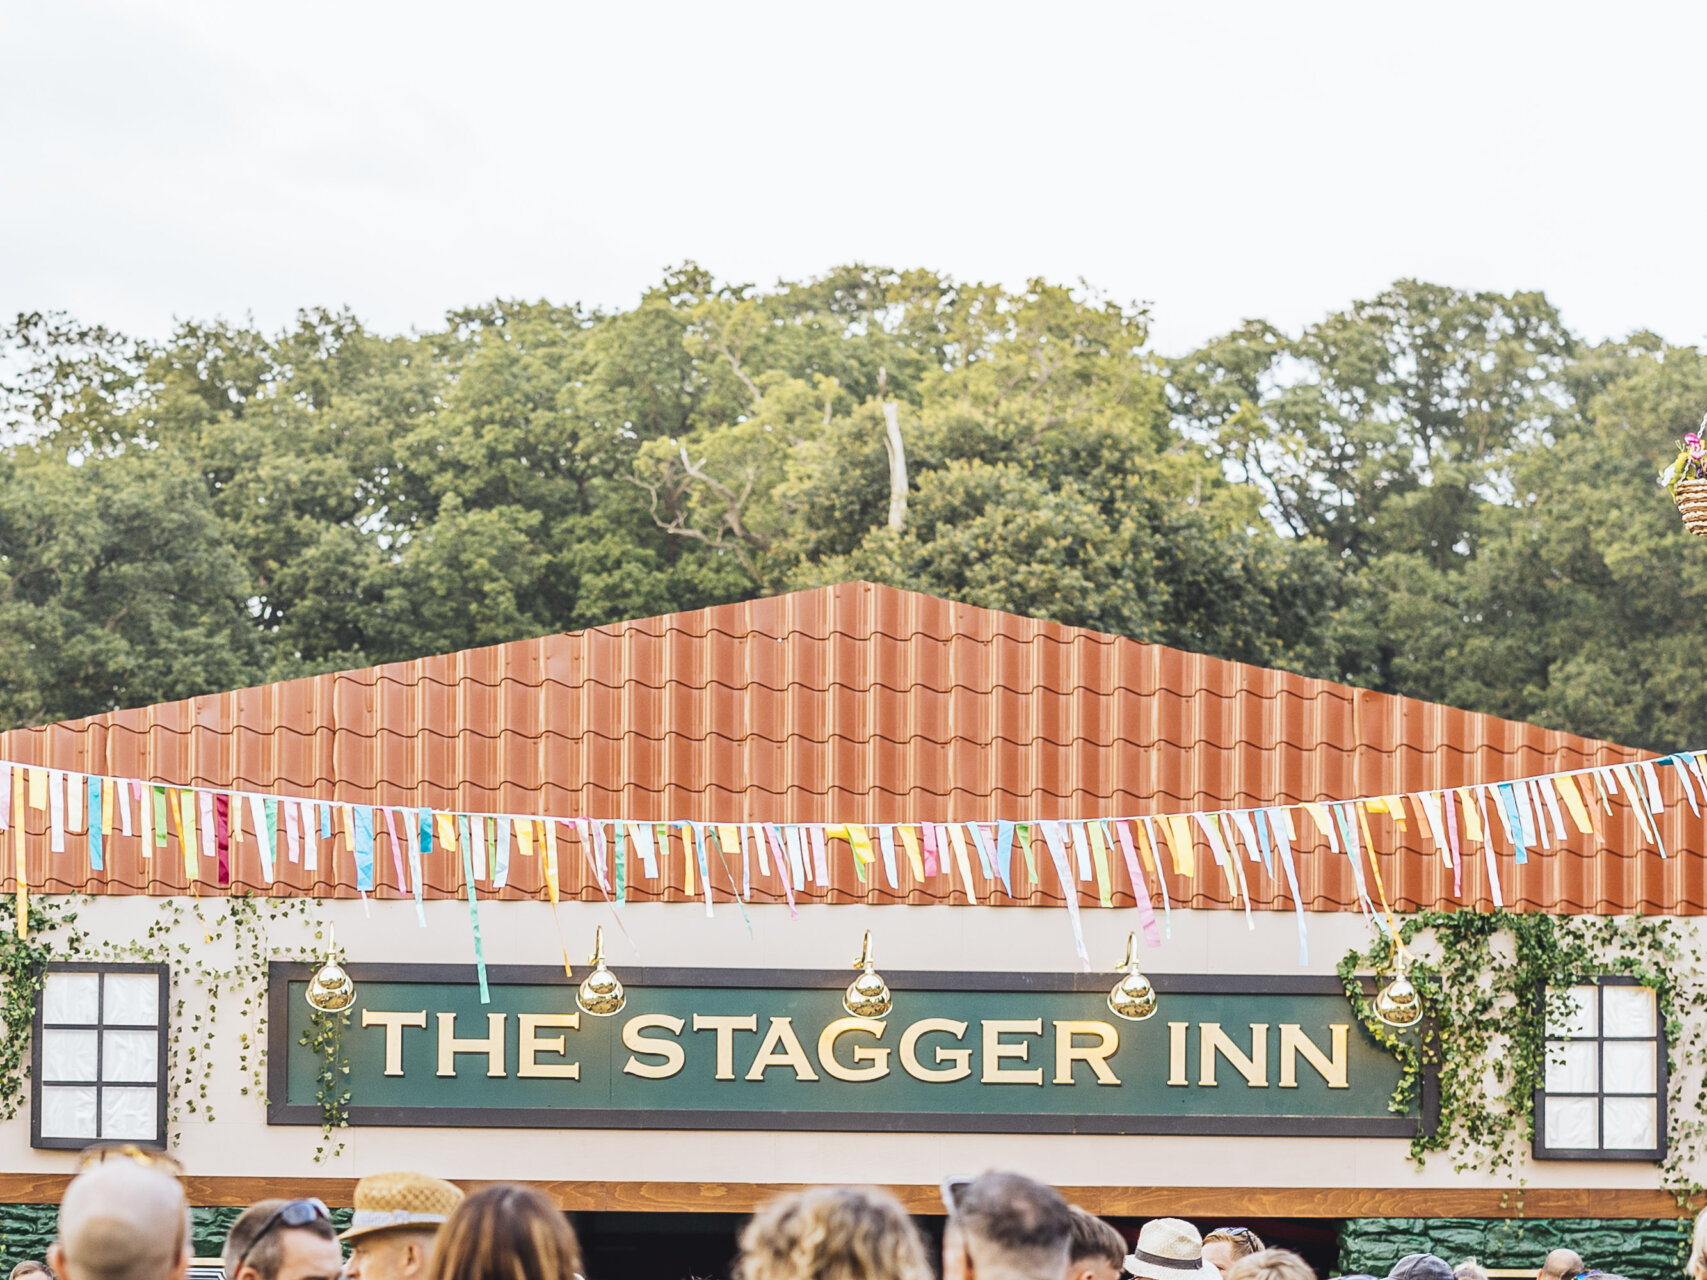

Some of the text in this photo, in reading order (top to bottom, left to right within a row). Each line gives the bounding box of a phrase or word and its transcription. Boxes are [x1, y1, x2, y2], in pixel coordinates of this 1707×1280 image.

[361, 1008, 1351, 1090] THE STAGGER INN
